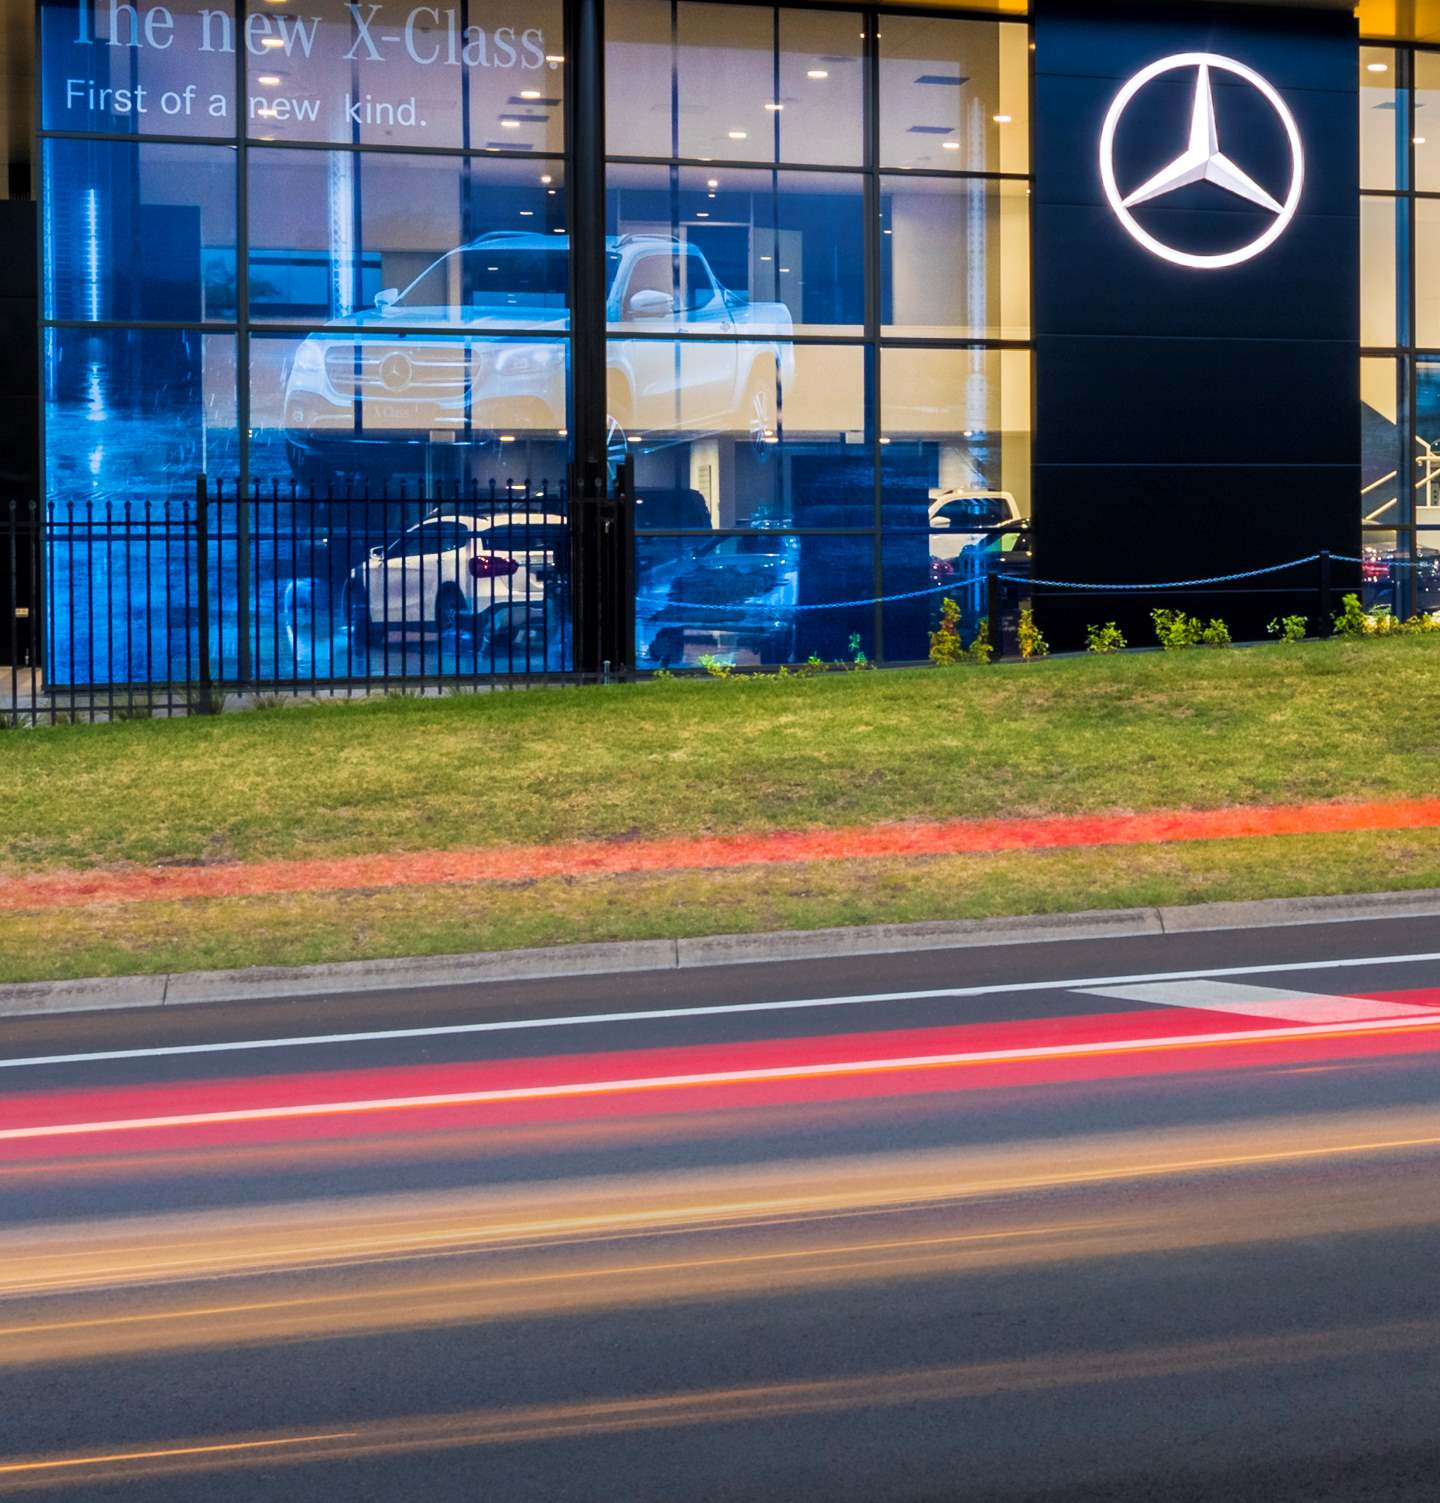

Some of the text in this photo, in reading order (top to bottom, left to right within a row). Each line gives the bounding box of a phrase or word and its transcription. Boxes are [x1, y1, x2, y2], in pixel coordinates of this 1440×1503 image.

[198, 9, 322, 58] new
[66, 78, 427, 127] First of a new kind.
